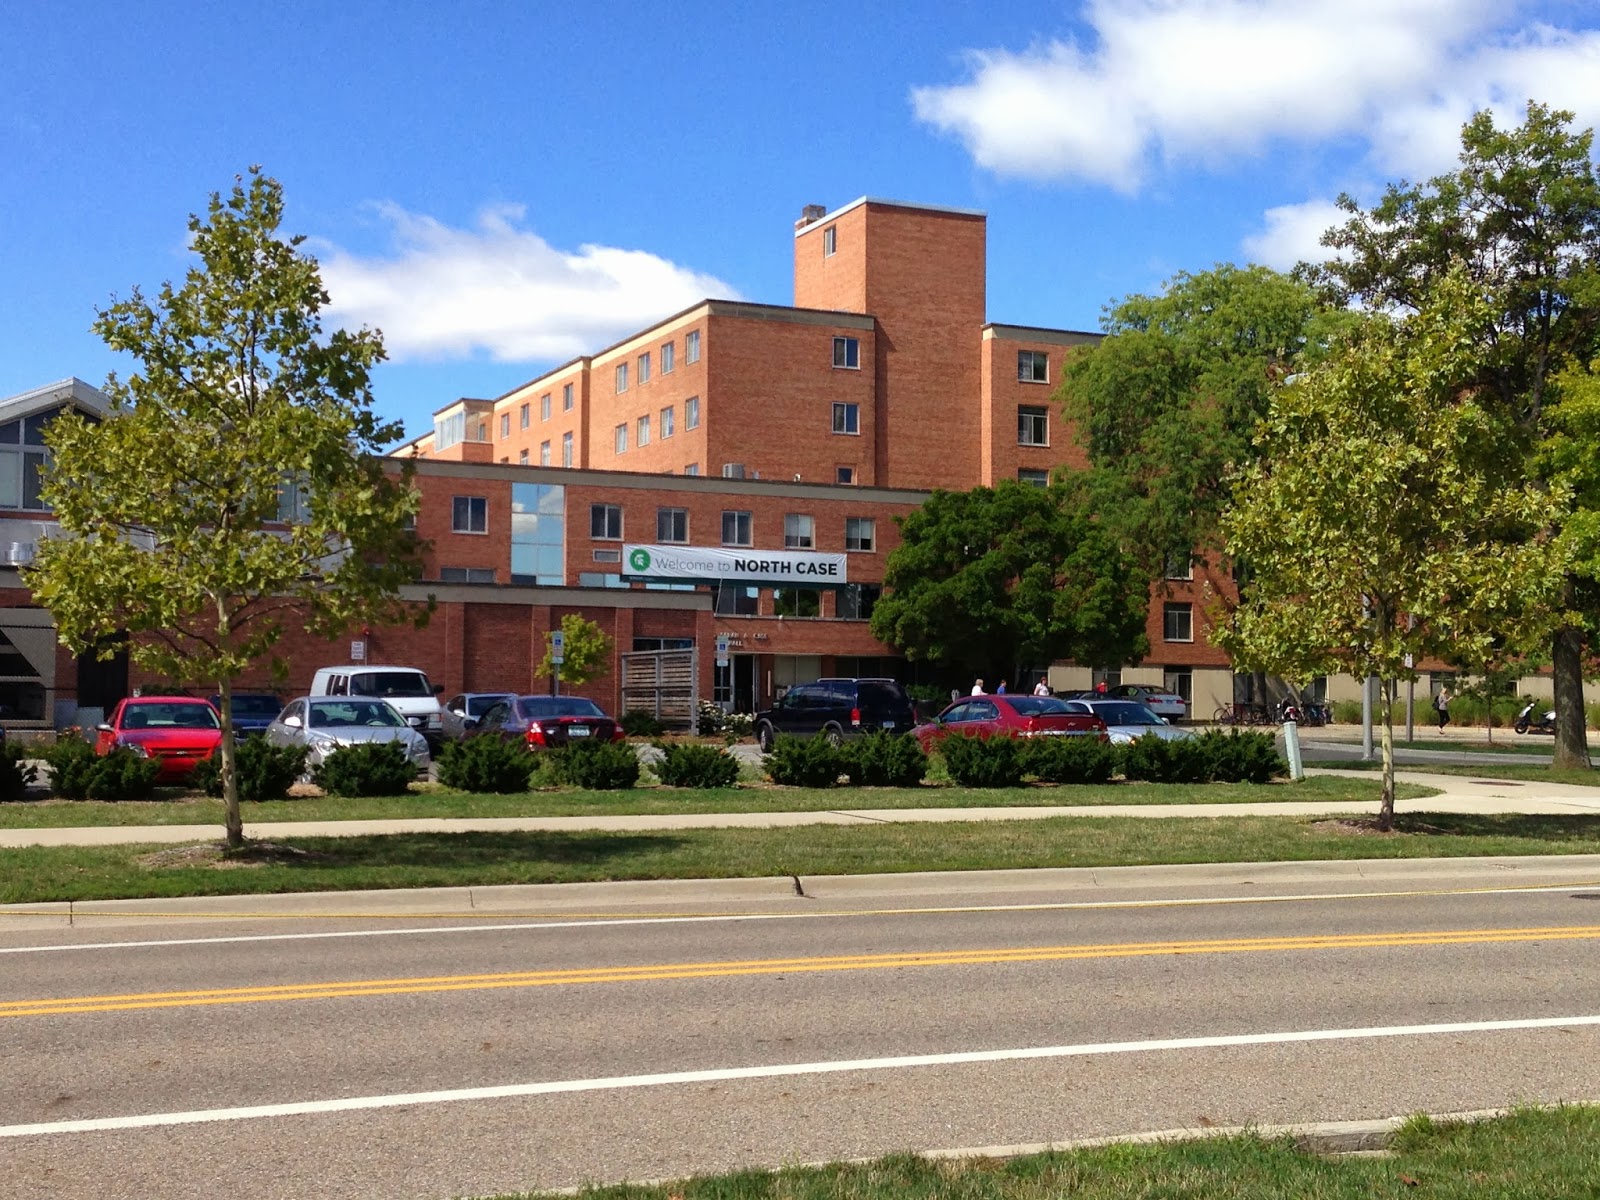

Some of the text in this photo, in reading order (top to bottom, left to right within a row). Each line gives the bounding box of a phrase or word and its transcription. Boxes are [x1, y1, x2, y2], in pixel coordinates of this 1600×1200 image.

[655, 557, 837, 575] Welcome to NORTH CASE
